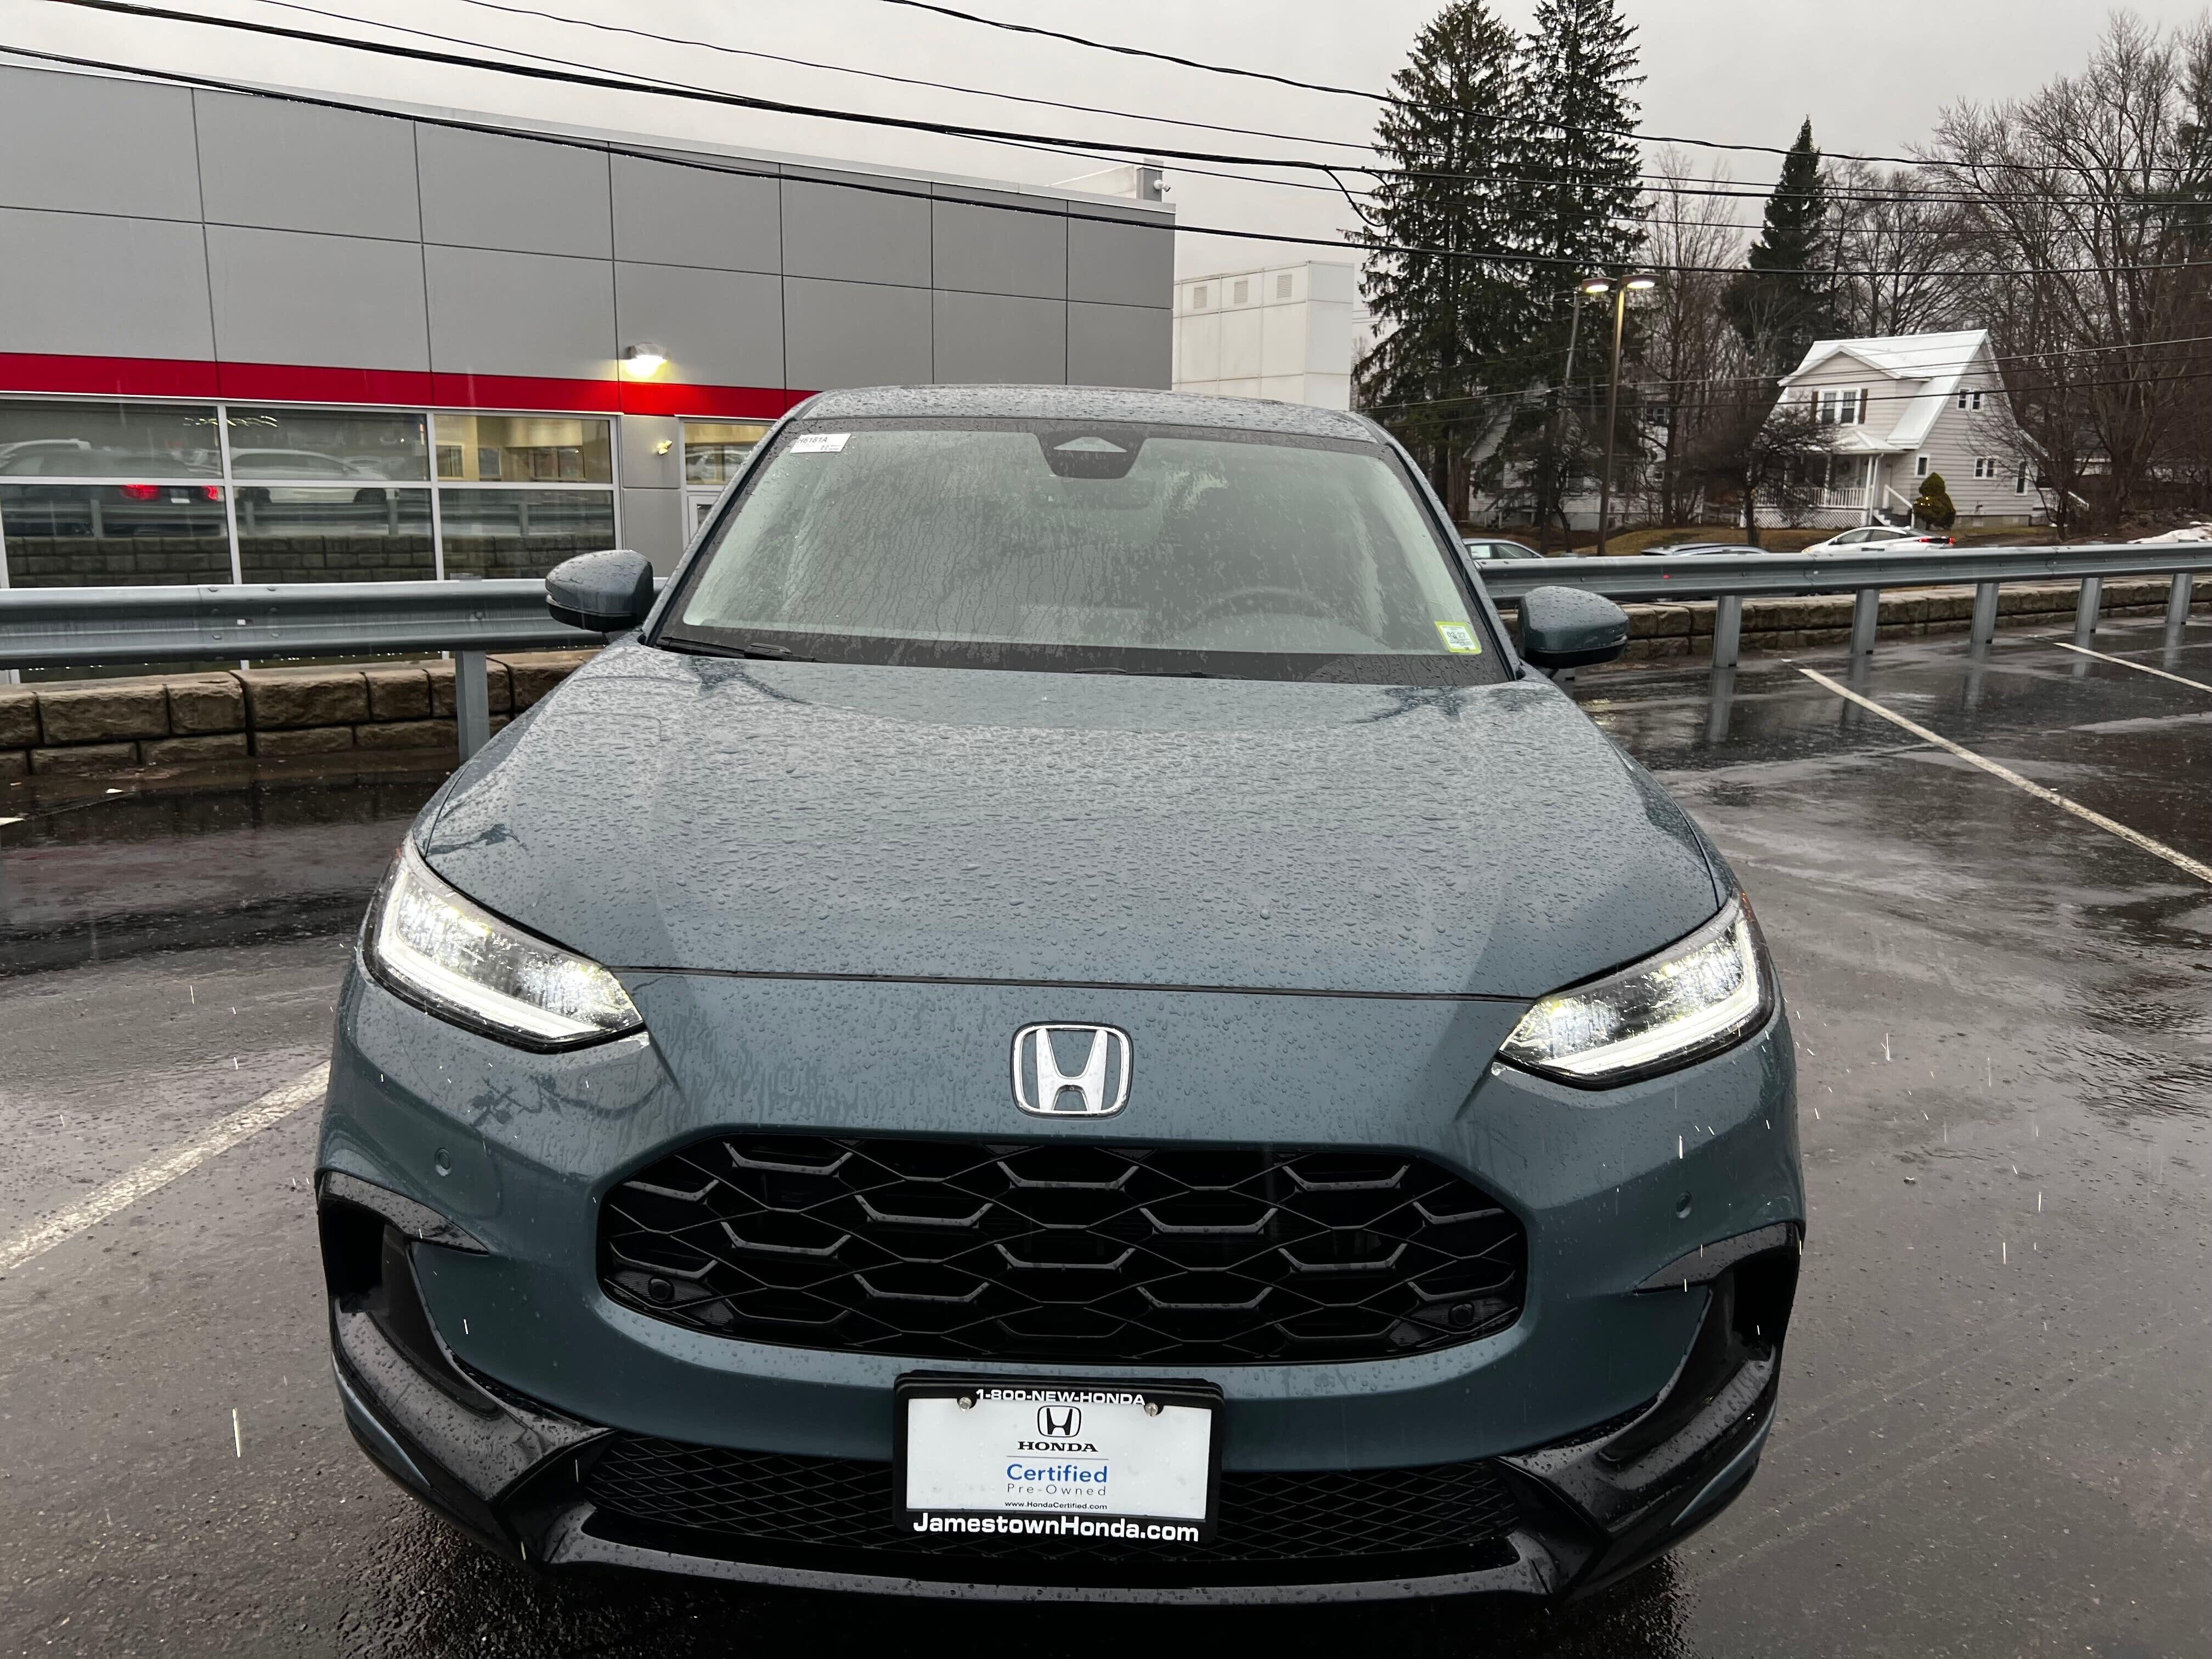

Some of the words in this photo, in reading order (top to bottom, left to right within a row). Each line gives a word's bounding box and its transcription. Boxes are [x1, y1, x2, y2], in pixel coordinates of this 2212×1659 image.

[976, 1389, 1146, 1405] 1-800-NEW-HONDA
[1018, 1441, 1098, 1452] HONDA
[1007, 1464, 1108, 1483] Certified
[1007, 1483, 1107, 1496] Pre-Owned
[1005, 1501, 1108, 1510] www.HondaCertified.com
[913, 1512, 1199, 1542] JamestownHonda.com
